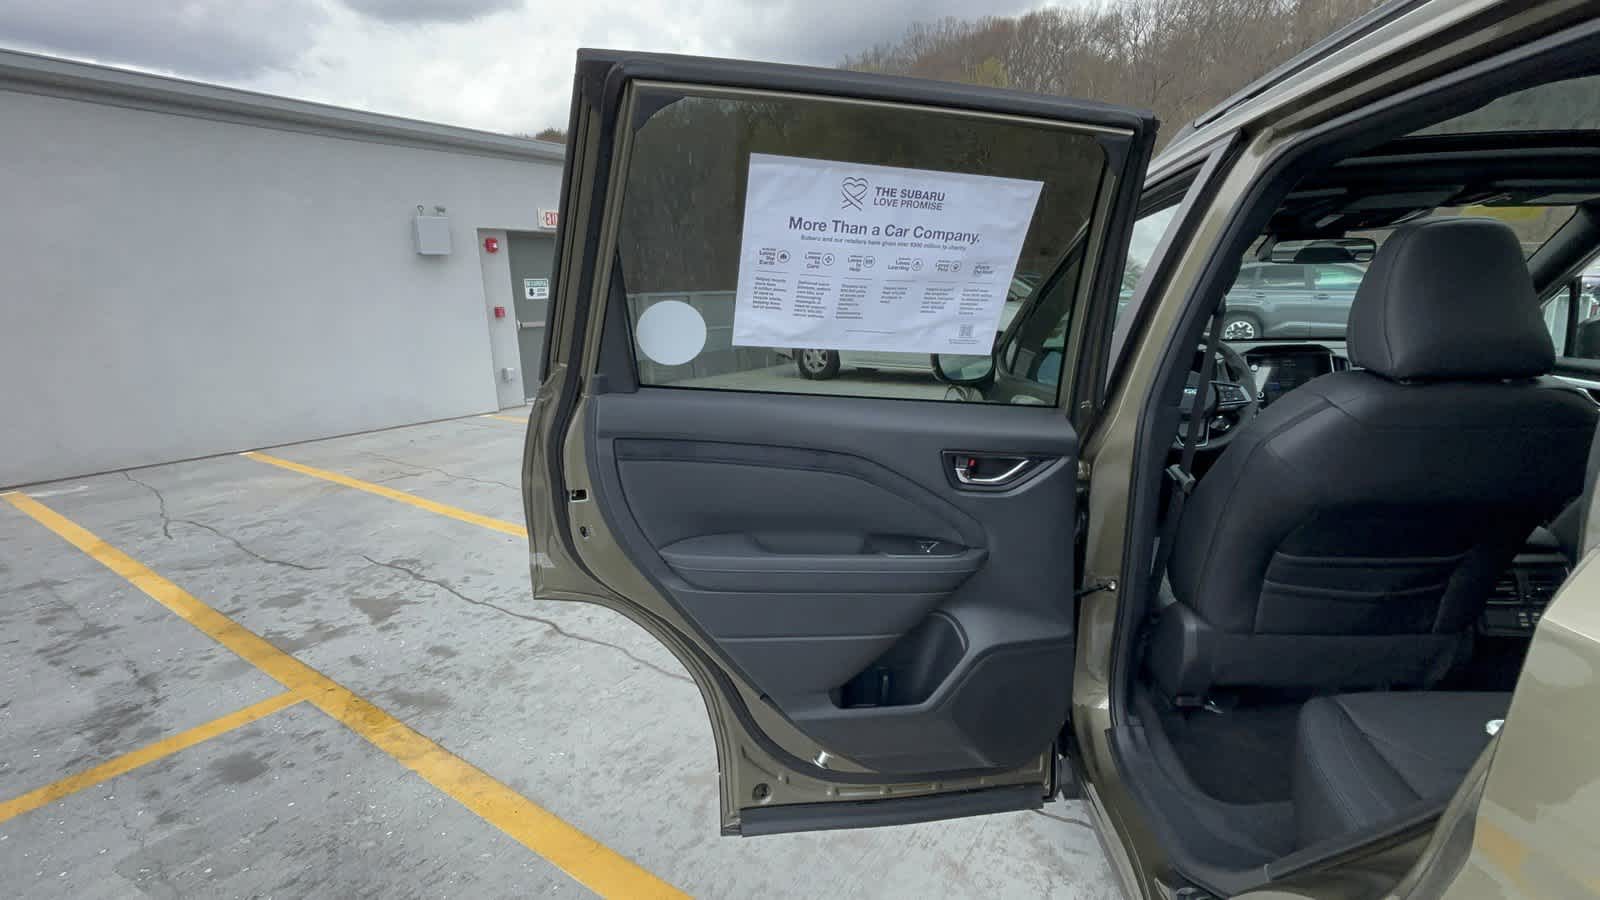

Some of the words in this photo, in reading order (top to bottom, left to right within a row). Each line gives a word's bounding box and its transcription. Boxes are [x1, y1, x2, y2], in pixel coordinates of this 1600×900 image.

[876, 187, 897, 198] THE
[900, 189, 945, 201] SUBARU
[874, 198, 898, 208] LOVE
[901, 200, 944, 211] PROMISE
[788, 217, 827, 232] More
[832, 220, 867, 236] Than
[872, 226, 880, 236] a
[884, 224, 910, 238] Car
[913, 226, 981, 245] Company.
